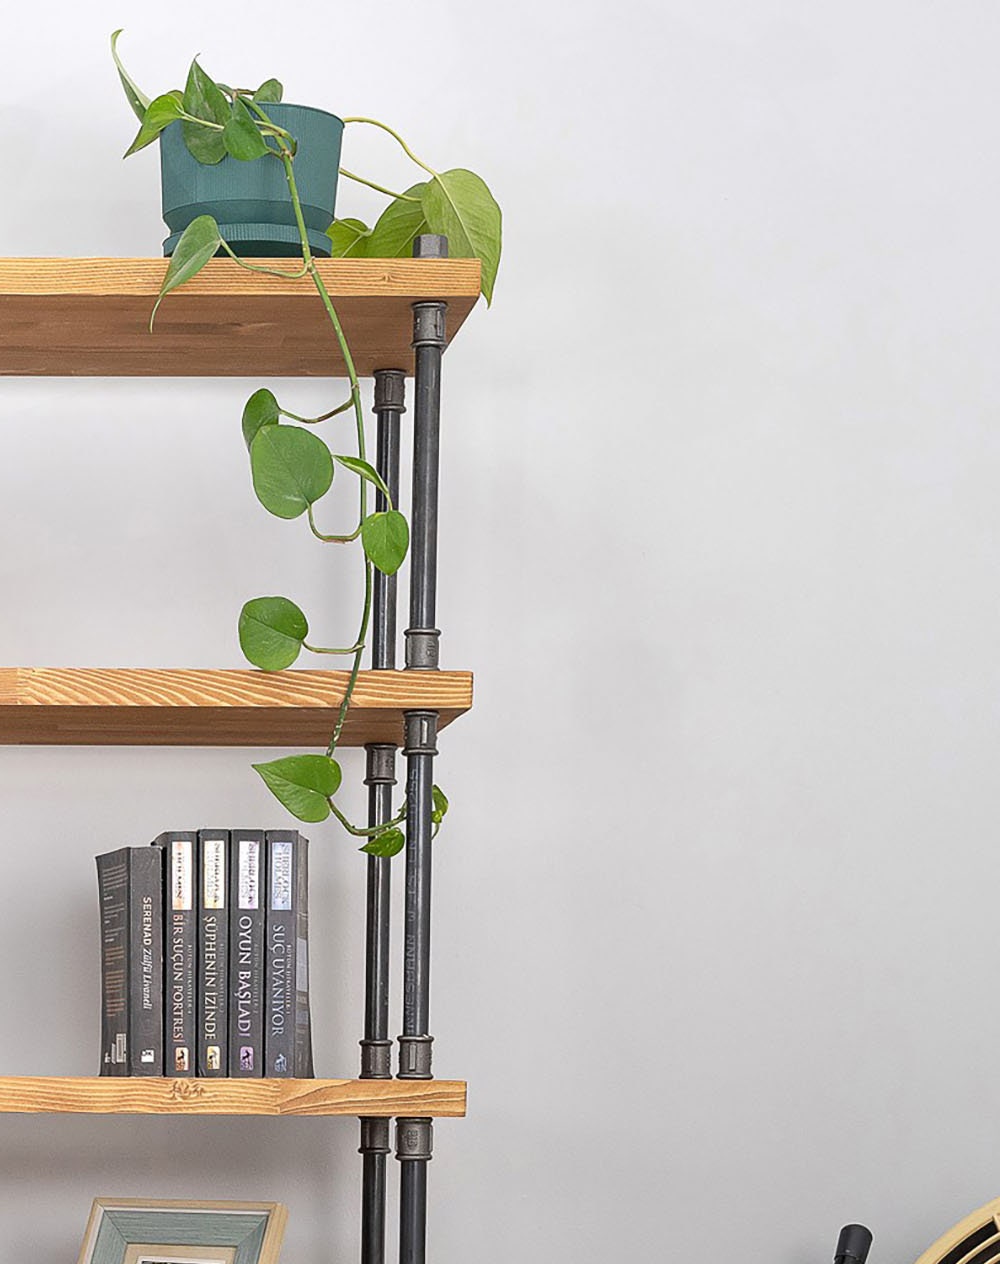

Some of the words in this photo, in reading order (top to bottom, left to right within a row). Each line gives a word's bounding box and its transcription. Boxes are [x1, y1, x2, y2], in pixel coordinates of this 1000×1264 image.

[281, 844, 290, 904] SHERLOCK
[142, 896, 152, 946] SERENAD
[173, 914, 186, 935] BİR
[238, 915, 252, 965] OYUN
[268, 924, 285, 956] SUÇ
[170, 938, 184, 982] SUÇUN
[202, 916, 218, 987] ŞÜPHENİN
[203, 992, 218, 1040] İZİNDE
[234, 971, 252, 1037] BAŞLADI
[271, 959, 285, 1036] UYANIYOR
